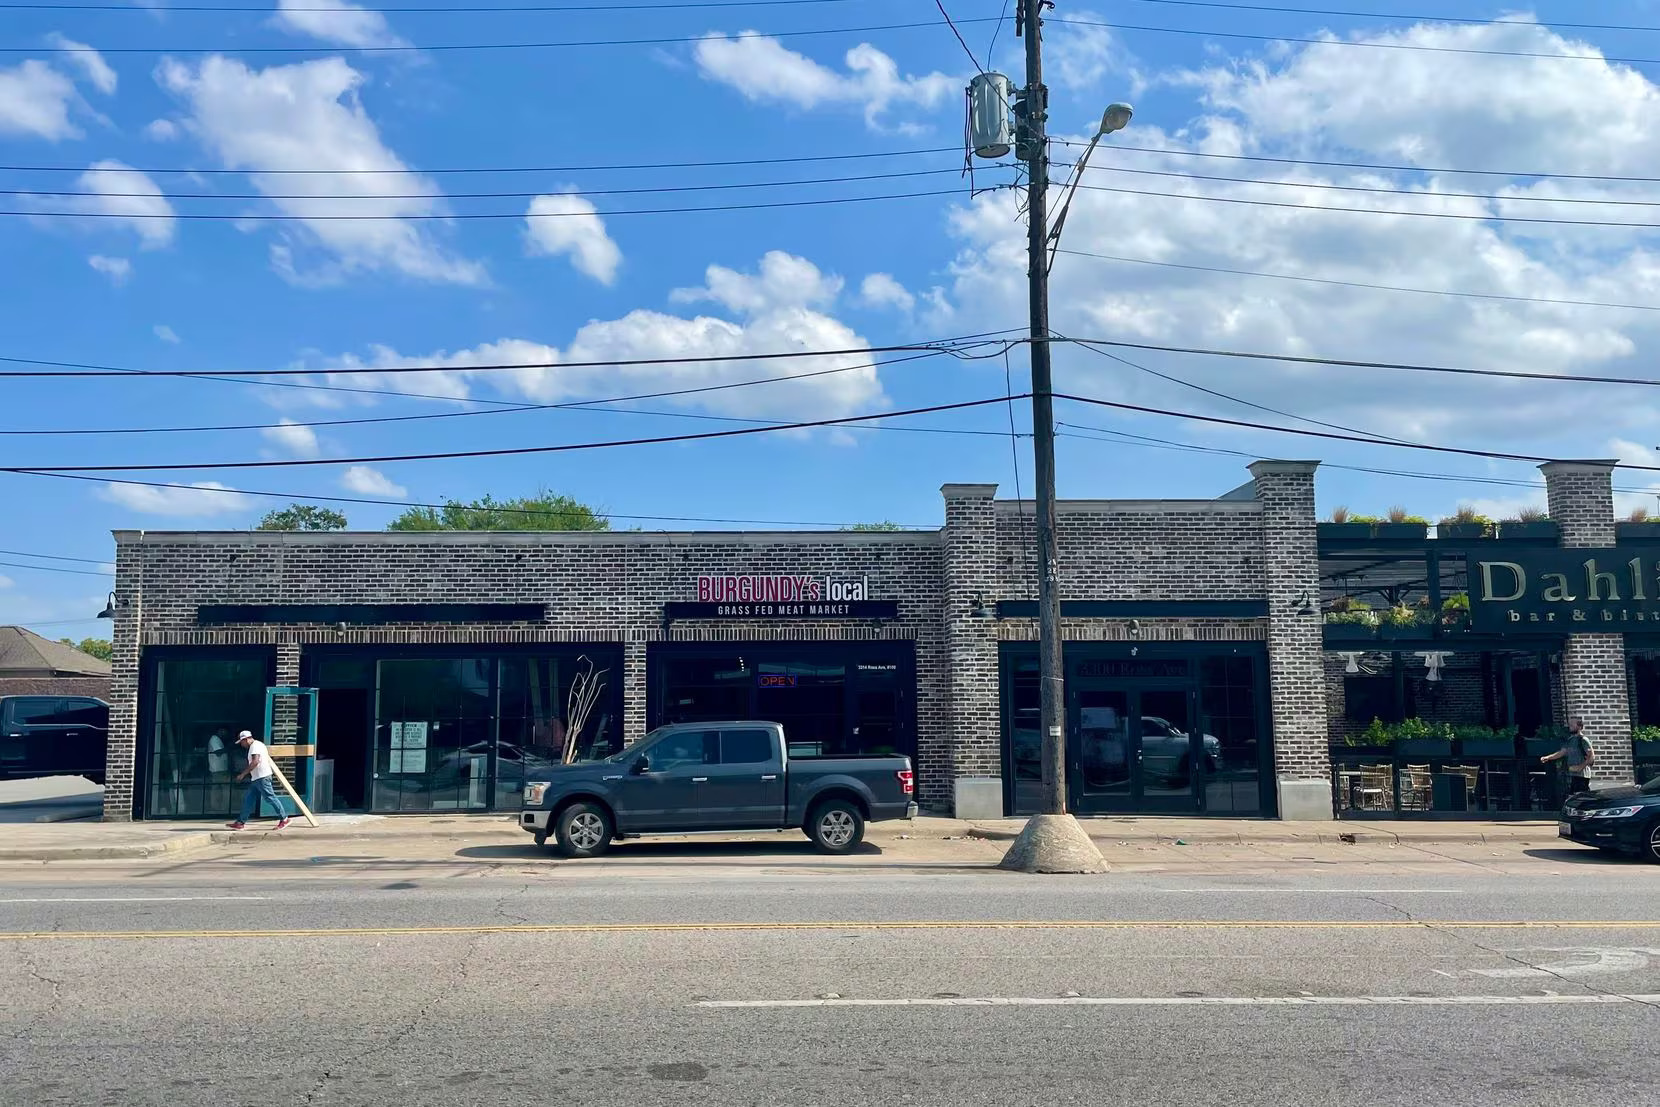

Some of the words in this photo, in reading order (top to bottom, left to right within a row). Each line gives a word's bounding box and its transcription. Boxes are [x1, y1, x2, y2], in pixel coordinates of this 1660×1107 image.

[697, 575, 821, 602] BURGUNDY's
[825, 575, 869, 601] local
[718, 605, 750, 615] GRASS
[755, 605, 773, 615] FED
[778, 605, 805, 615] MEAT
[809, 604, 850, 615] MARKET
[1507, 609, 1555, 621] bar
[1572, 609, 1587, 621] &
[760, 676, 795, 686] OPEN
